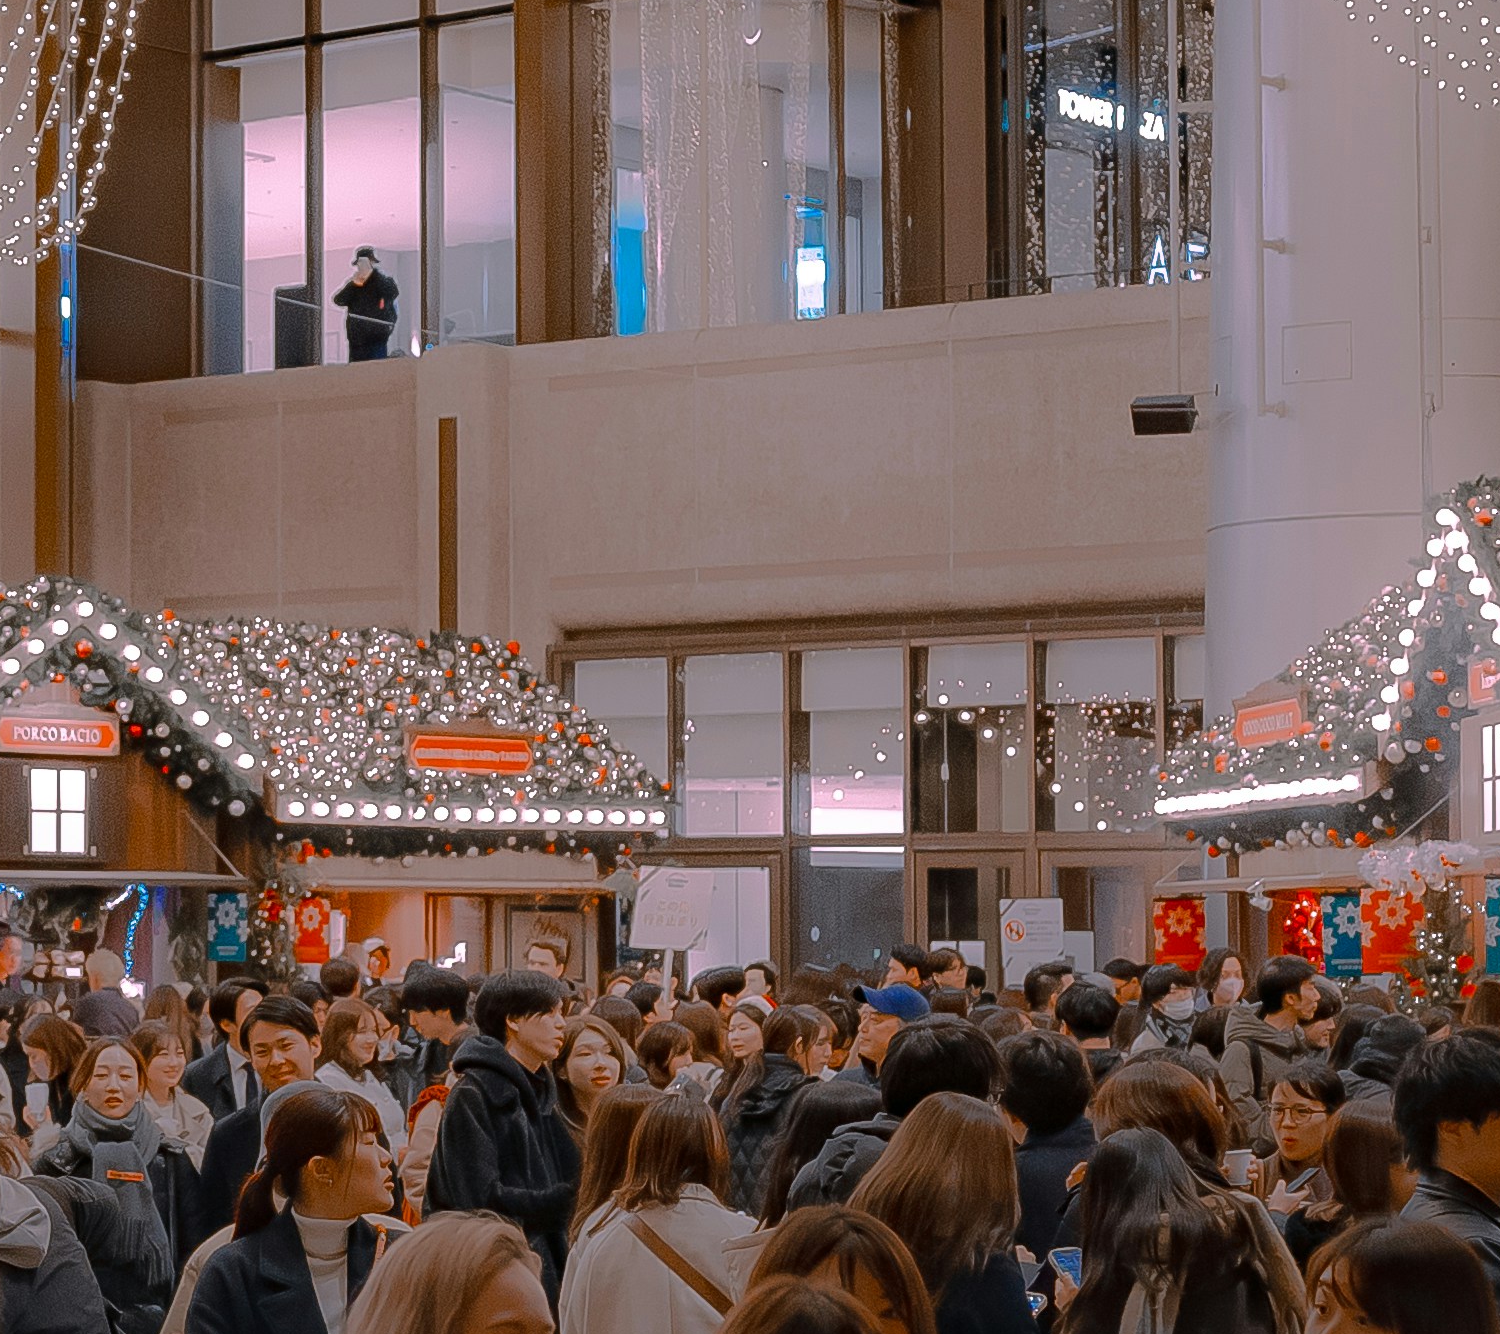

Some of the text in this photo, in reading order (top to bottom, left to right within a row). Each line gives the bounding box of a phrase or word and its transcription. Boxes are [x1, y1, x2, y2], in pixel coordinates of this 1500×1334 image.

[1057, 88, 1114, 129] TOWER
[13, 726, 100, 743] PORCO BACIO
